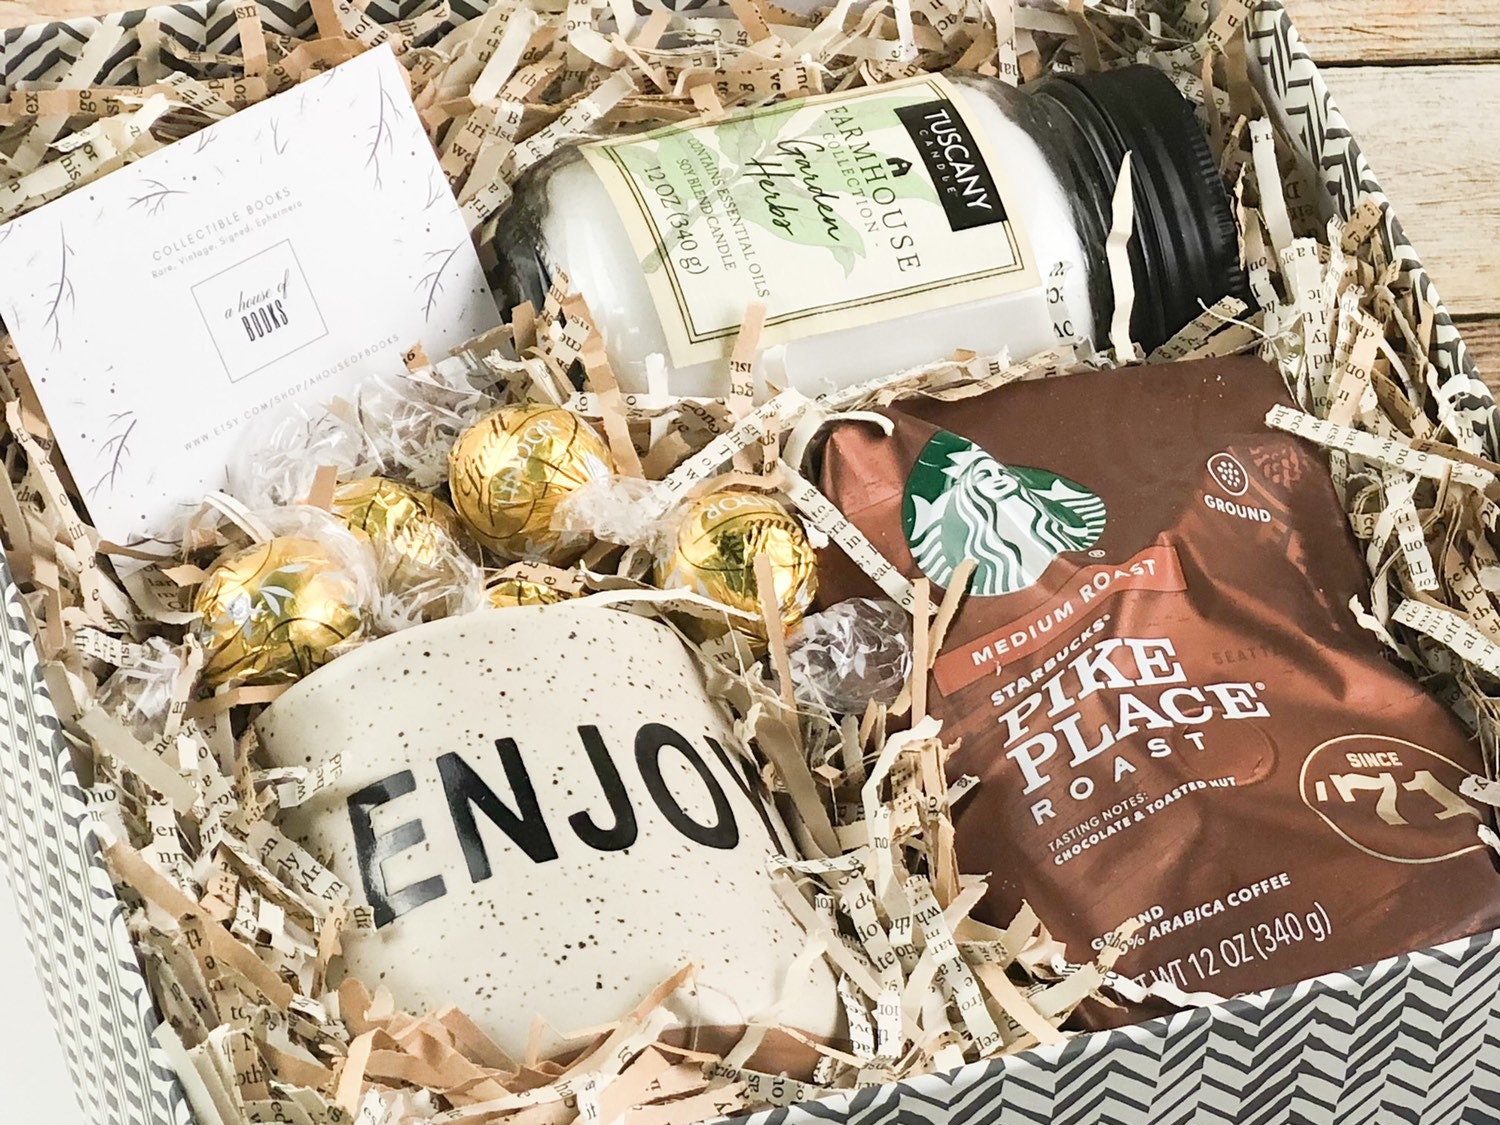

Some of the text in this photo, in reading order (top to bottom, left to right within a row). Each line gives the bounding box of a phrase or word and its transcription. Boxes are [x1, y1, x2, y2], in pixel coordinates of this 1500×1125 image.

[237, 5, 256, 19] us
[24, 91, 39, 114] ex
[78, 90, 97, 113] ge
[507, 111, 518, 124] B
[81, 142, 99, 162] or
[821, 131, 879, 234] COLLECTION
[918, 128, 956, 195] CANDLE
[922, 108, 993, 212] TUSCANY
[644, 164, 710, 276] 12 OZ (340 g)
[675, 157, 737, 271] SOY BLEND CANDLE
[686, 136, 771, 298] CONTAINS ESSENTIAL OILS
[742, 156, 796, 238] Herbs
[777, 139, 842, 242] Garden
[824, 105, 922, 273] FARMHOUSE
[152, 187, 292, 262] COLLECTIBLE BOOKS
[178, 242, 218, 266] Vintage,
[219, 223, 254, 247] Signed,
[224, 267, 290, 320] a house of
[1250, 256, 1267, 269] on
[1308, 289, 1323, 301] ic
[240, 299, 289, 342] BOOKS
[1311, 330, 1329, 345] ty
[720, 446, 731, 458] T
[845, 534, 861, 548] in
[1204, 494, 1272, 523] GROUND
[1403, 541, 1424, 553] on
[971, 557, 1158, 667] MEDIUM ROAST
[991, 616, 1106, 707] STARBUCKS
[998, 637, 1188, 749] PIKE
[1006, 682, 1271, 796] PLACE
[1345, 751, 1403, 769] SINCE
[1030, 732, 1206, 826] ROAST
[1315, 769, 1486, 826] '71
[346, 722, 786, 930] ENJOY
[1048, 791, 1150, 853] TASTING NOTES:
[1053, 776, 1237, 867] CHOCOLATE & TOASTED NUT
[1148, 899, 1226, 941] ARABICA
[1226, 872, 1292, 907] COFFEE
[1188, 947, 1221, 980] 12
[1220, 933, 1254, 969] OZ
[1250, 911, 1304, 961] (340
[1306, 901, 1333, 942] g)
